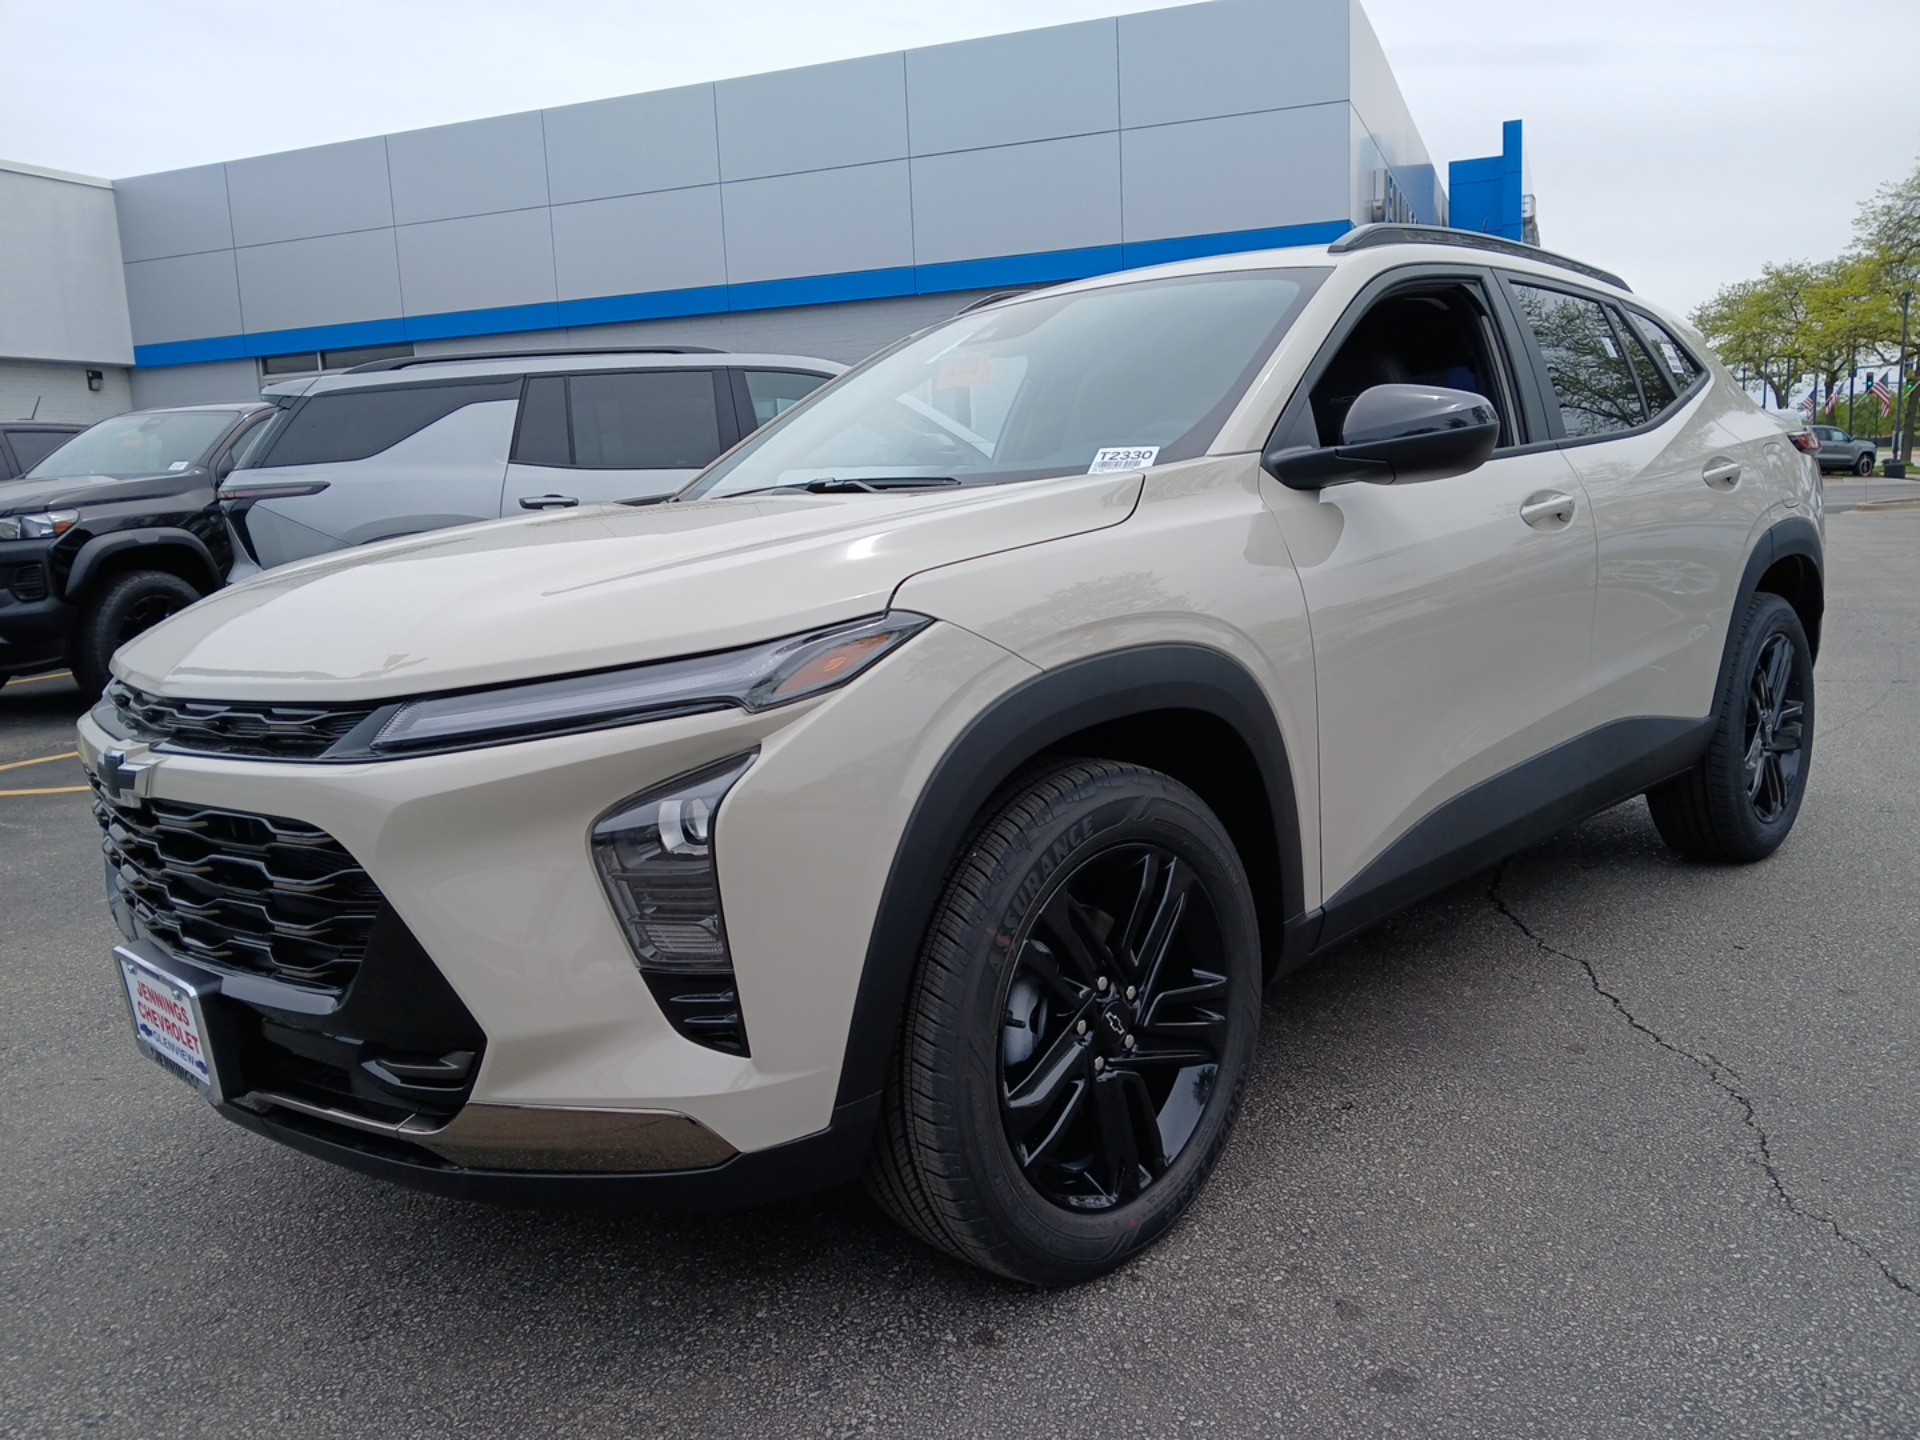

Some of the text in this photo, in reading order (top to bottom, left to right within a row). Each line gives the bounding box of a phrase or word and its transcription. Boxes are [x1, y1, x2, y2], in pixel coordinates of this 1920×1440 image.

[1100, 450, 1153, 461] T2330
[988, 816, 1095, 974] ASSURANCE
[138, 981, 191, 1027] JENNINGS
[138, 1000, 199, 1053] CHEVROLET
[152, 1031, 196, 1067] GLENVIEW
